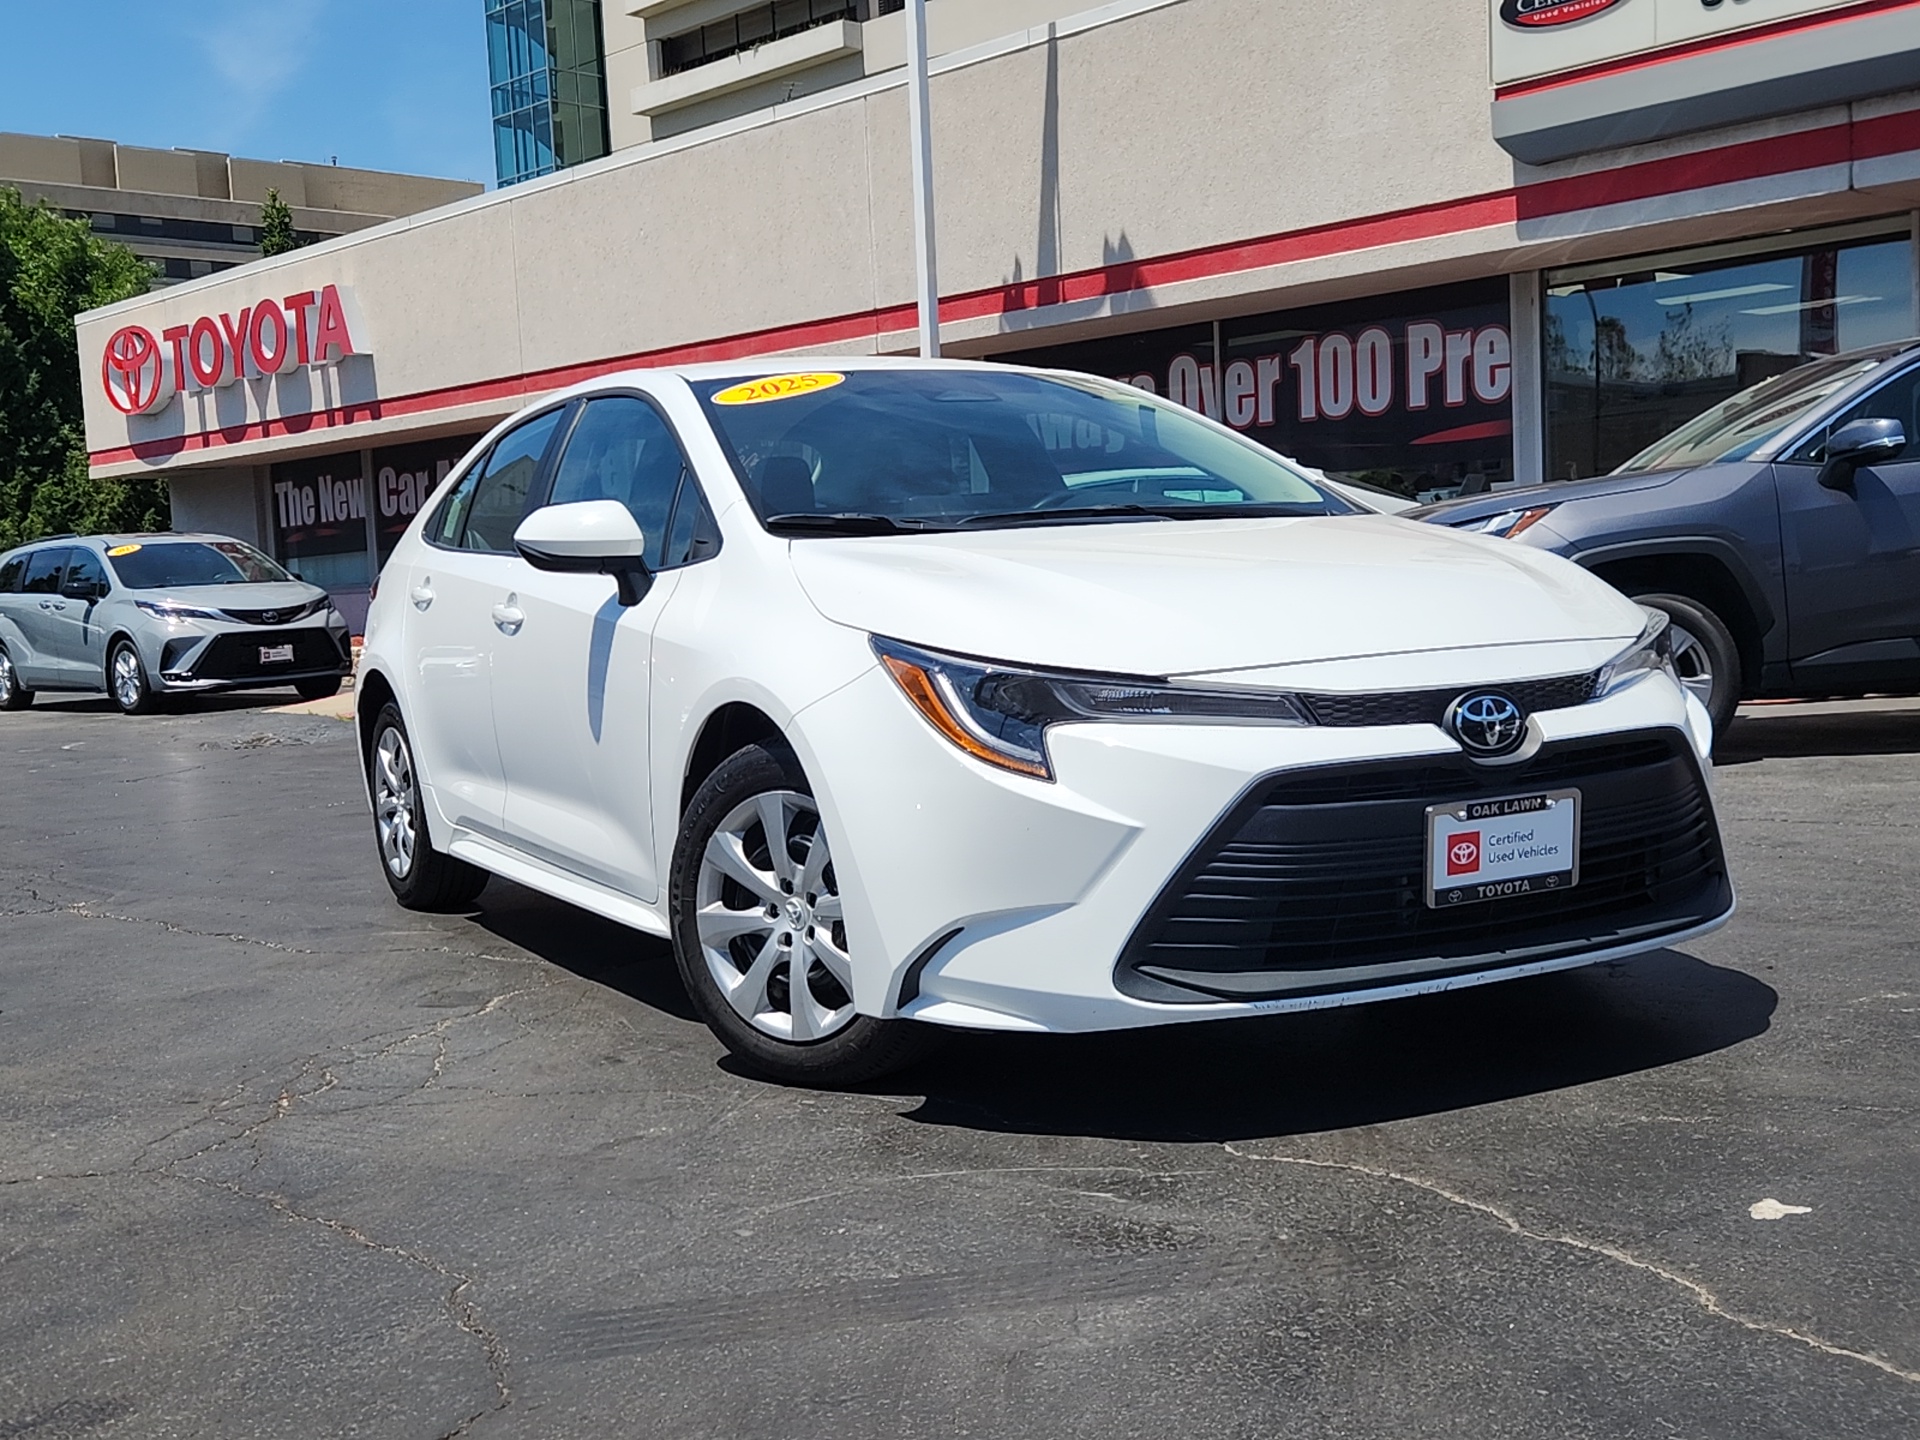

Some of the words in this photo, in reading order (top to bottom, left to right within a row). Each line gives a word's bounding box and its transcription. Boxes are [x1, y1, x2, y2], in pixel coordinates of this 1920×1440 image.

[1533, 9, 1559, 21] Used
[163, 284, 354, 391] TOYOTA
[1168, 354, 1281, 429] Over
[1290, 326, 1394, 420] 100
[1406, 320, 1512, 410] Pre
[739, 374, 819, 401] 2025
[274, 480, 316, 528] The
[317, 474, 366, 523] New
[378, 466, 430, 517] Car
[1472, 804, 1499, 818] OAK
[1503, 798, 1541, 814] LAWN
[1488, 829, 1534, 847] Certified
[1488, 851, 1515, 864] Used
[1516, 843, 1559, 860] Vehicles
[1477, 879, 1531, 898] TOYOTA
